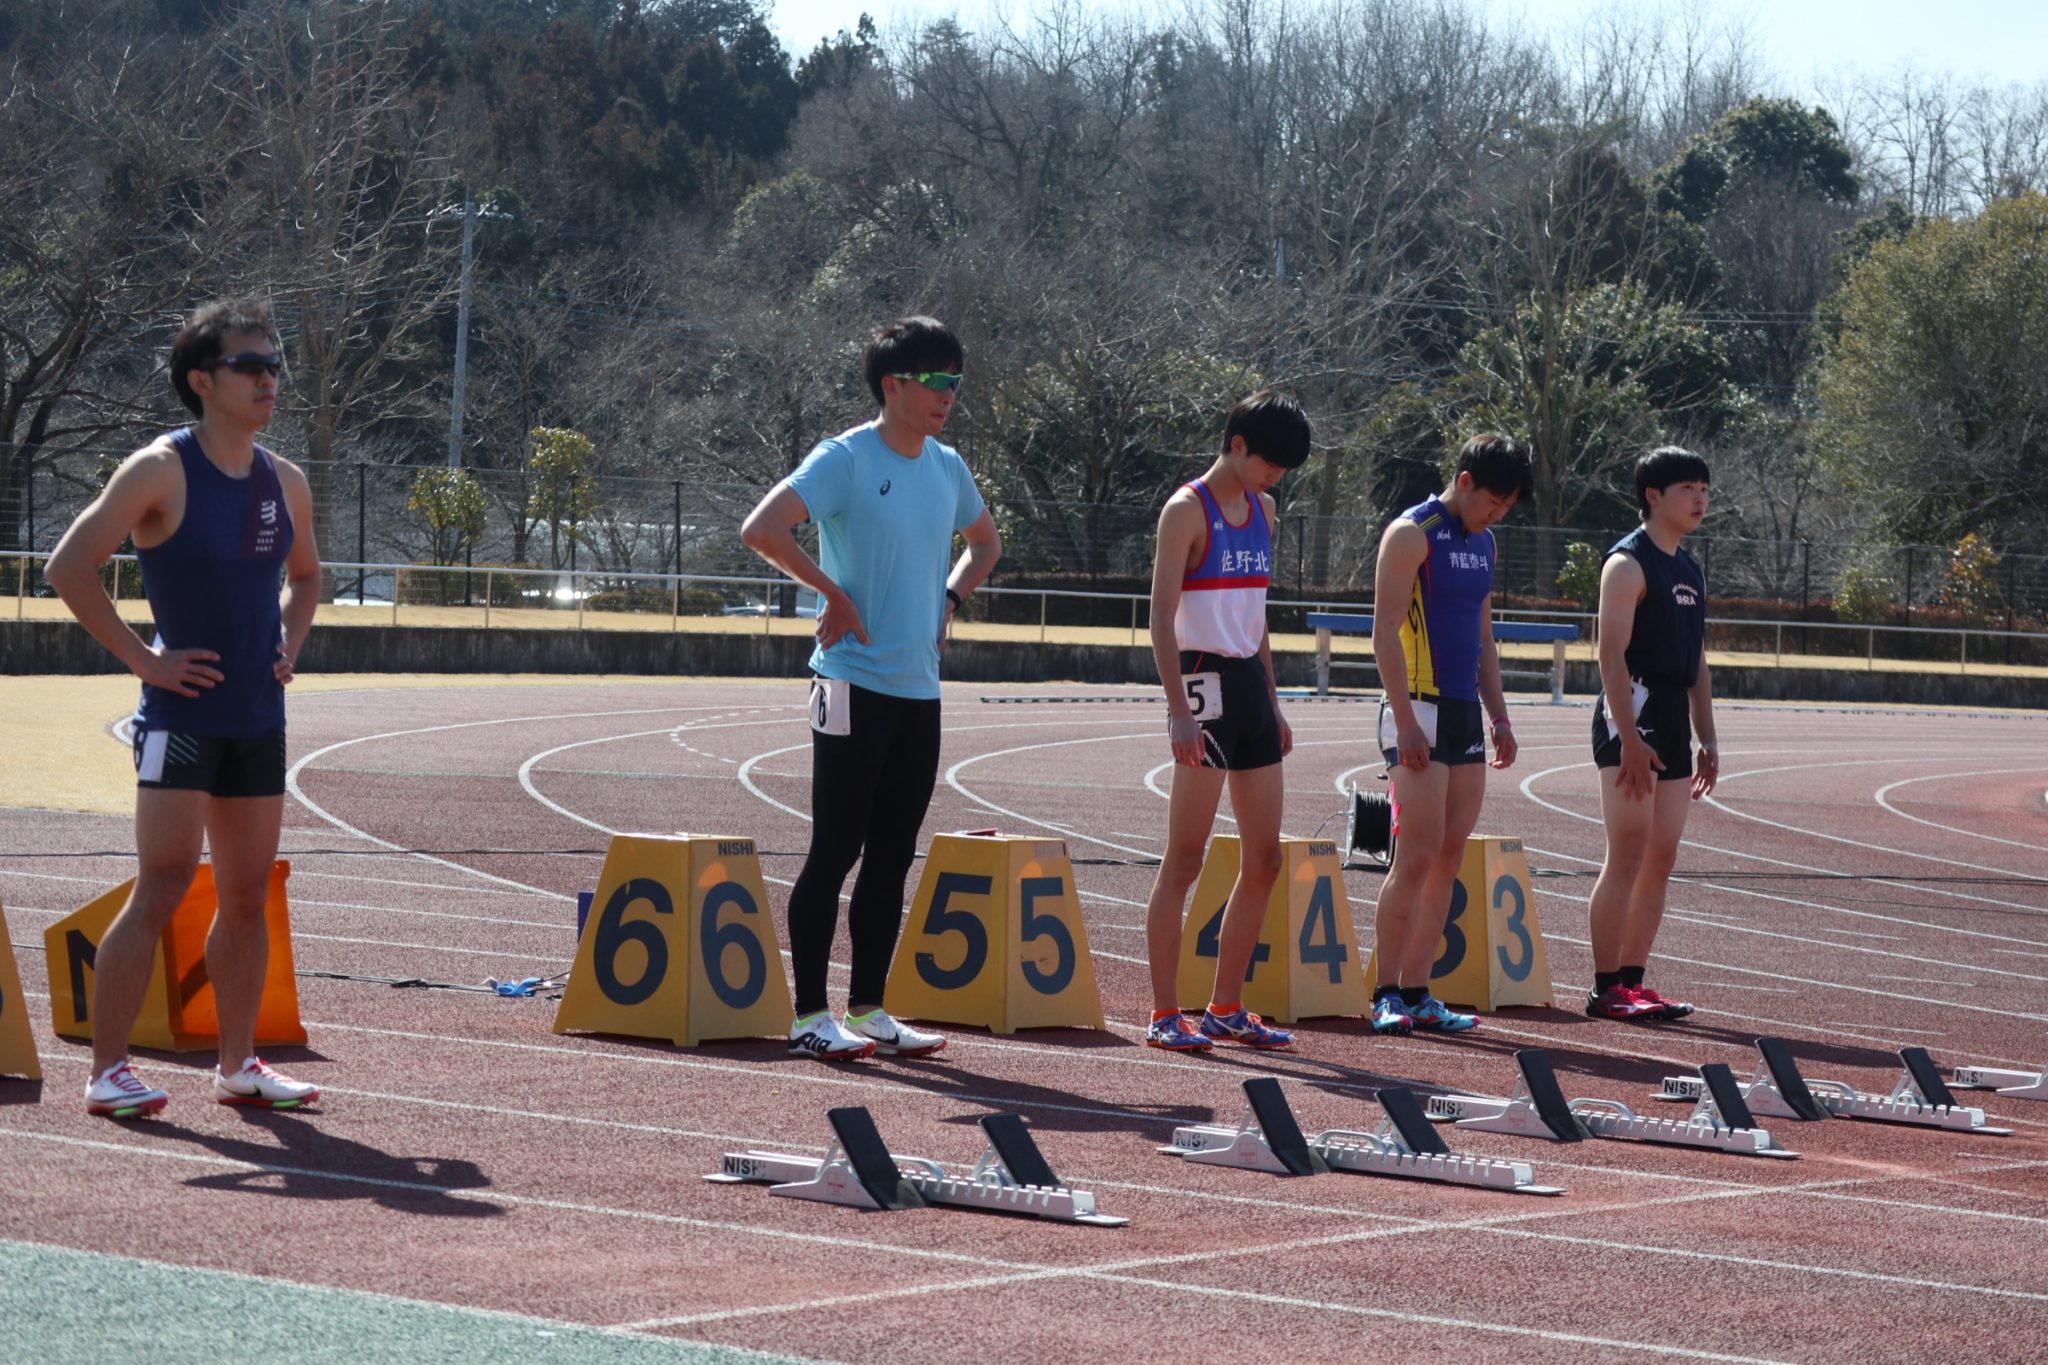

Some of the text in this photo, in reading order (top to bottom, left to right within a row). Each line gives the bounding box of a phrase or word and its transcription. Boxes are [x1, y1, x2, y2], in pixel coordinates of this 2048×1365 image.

[1222, 550, 1269, 573] 佐野北
[1187, 680, 1205, 716] 5
[718, 842, 754, 856] NISHI
[1309, 843, 1335, 856] NISHI
[1500, 841, 1522, 853] NISHI
[593, 878, 672, 1005] 6
[700, 881, 766, 1009] 6
[915, 872, 993, 989] 5
[1020, 877, 1075, 994] 5
[1299, 876, 1347, 984] 4
[1493, 875, 1534, 982] 3
